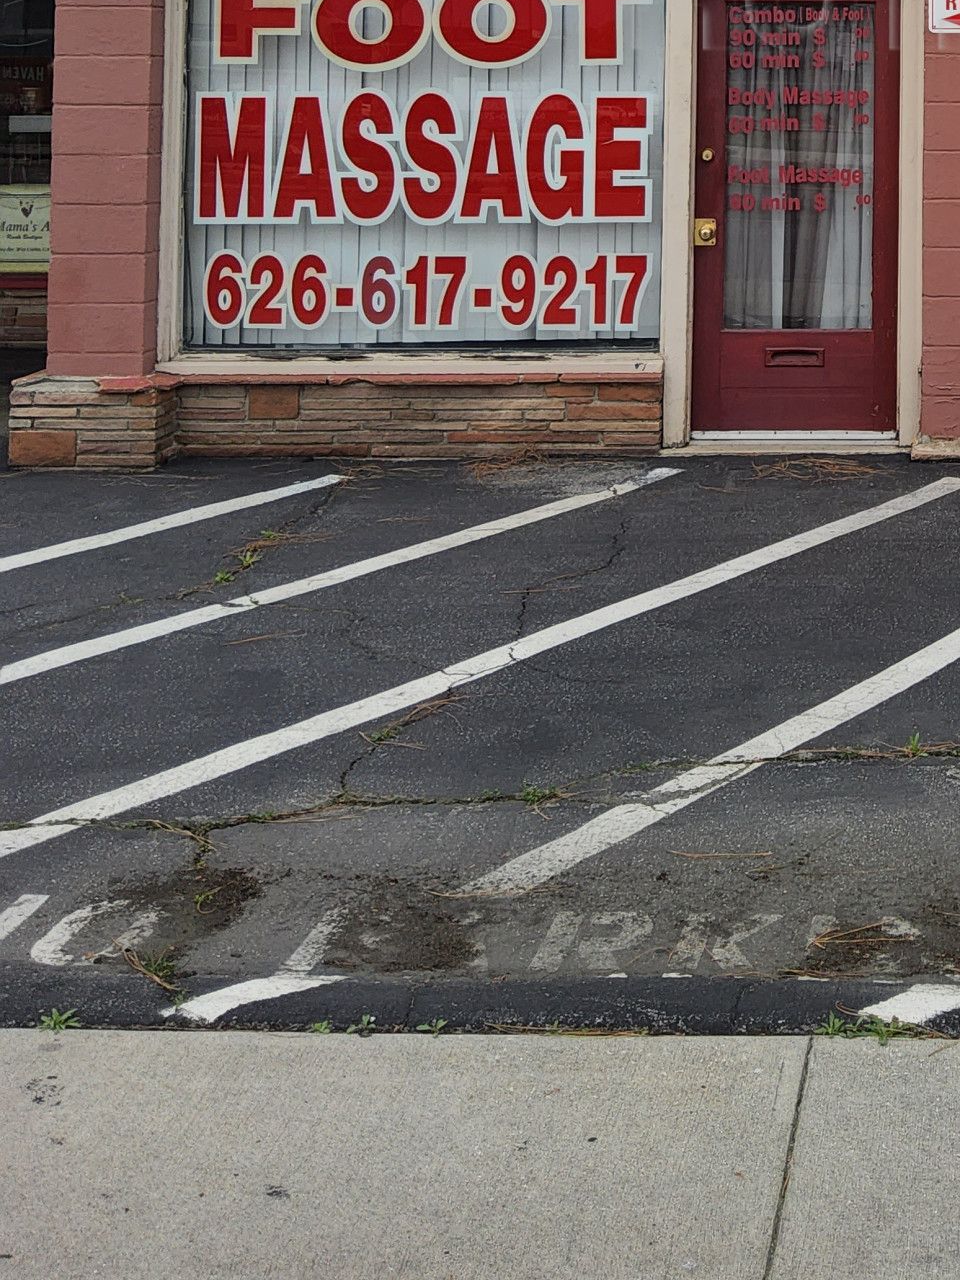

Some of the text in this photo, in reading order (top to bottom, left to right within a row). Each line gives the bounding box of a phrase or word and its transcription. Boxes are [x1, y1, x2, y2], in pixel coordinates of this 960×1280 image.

[729, 6, 796, 24] Combo
[729, 29, 755, 46] 90
[761, 28, 800, 46] min
[729, 51, 755, 69] 60
[761, 51, 800, 68] min
[728, 86, 869, 109] Body Massage
[761, 112, 799, 132] min
[194, 87, 654, 226] MASSAGE
[728, 165, 863, 188] Foot Massage
[761, 193, 800, 211] min
[203, 249, 653, 331] 626-617-9217
